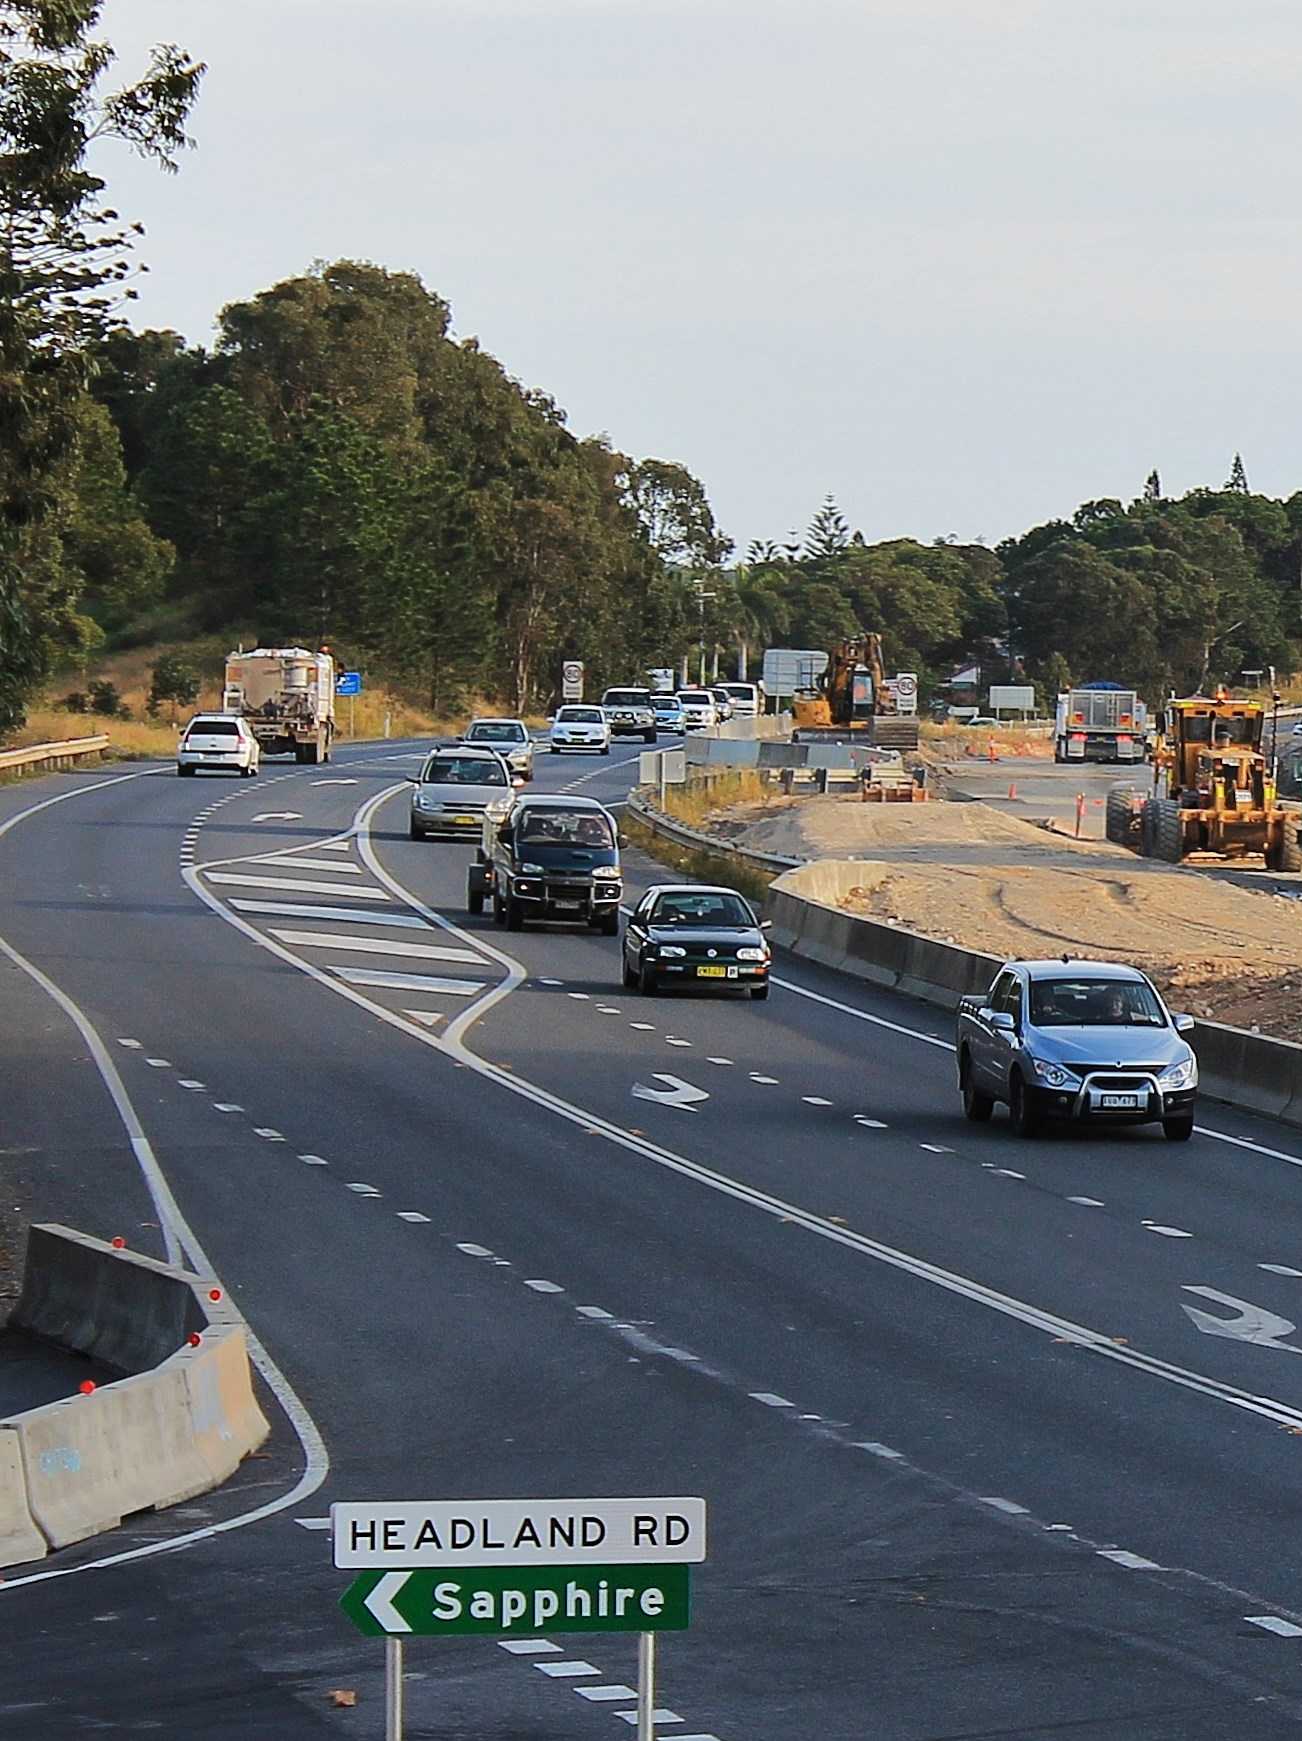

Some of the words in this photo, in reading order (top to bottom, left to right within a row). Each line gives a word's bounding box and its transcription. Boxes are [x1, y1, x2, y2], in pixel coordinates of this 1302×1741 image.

[350, 1516, 605, 1551] HEADLAND
[633, 1515, 690, 1546] RD
[431, 1580, 665, 1628] Sapphire
